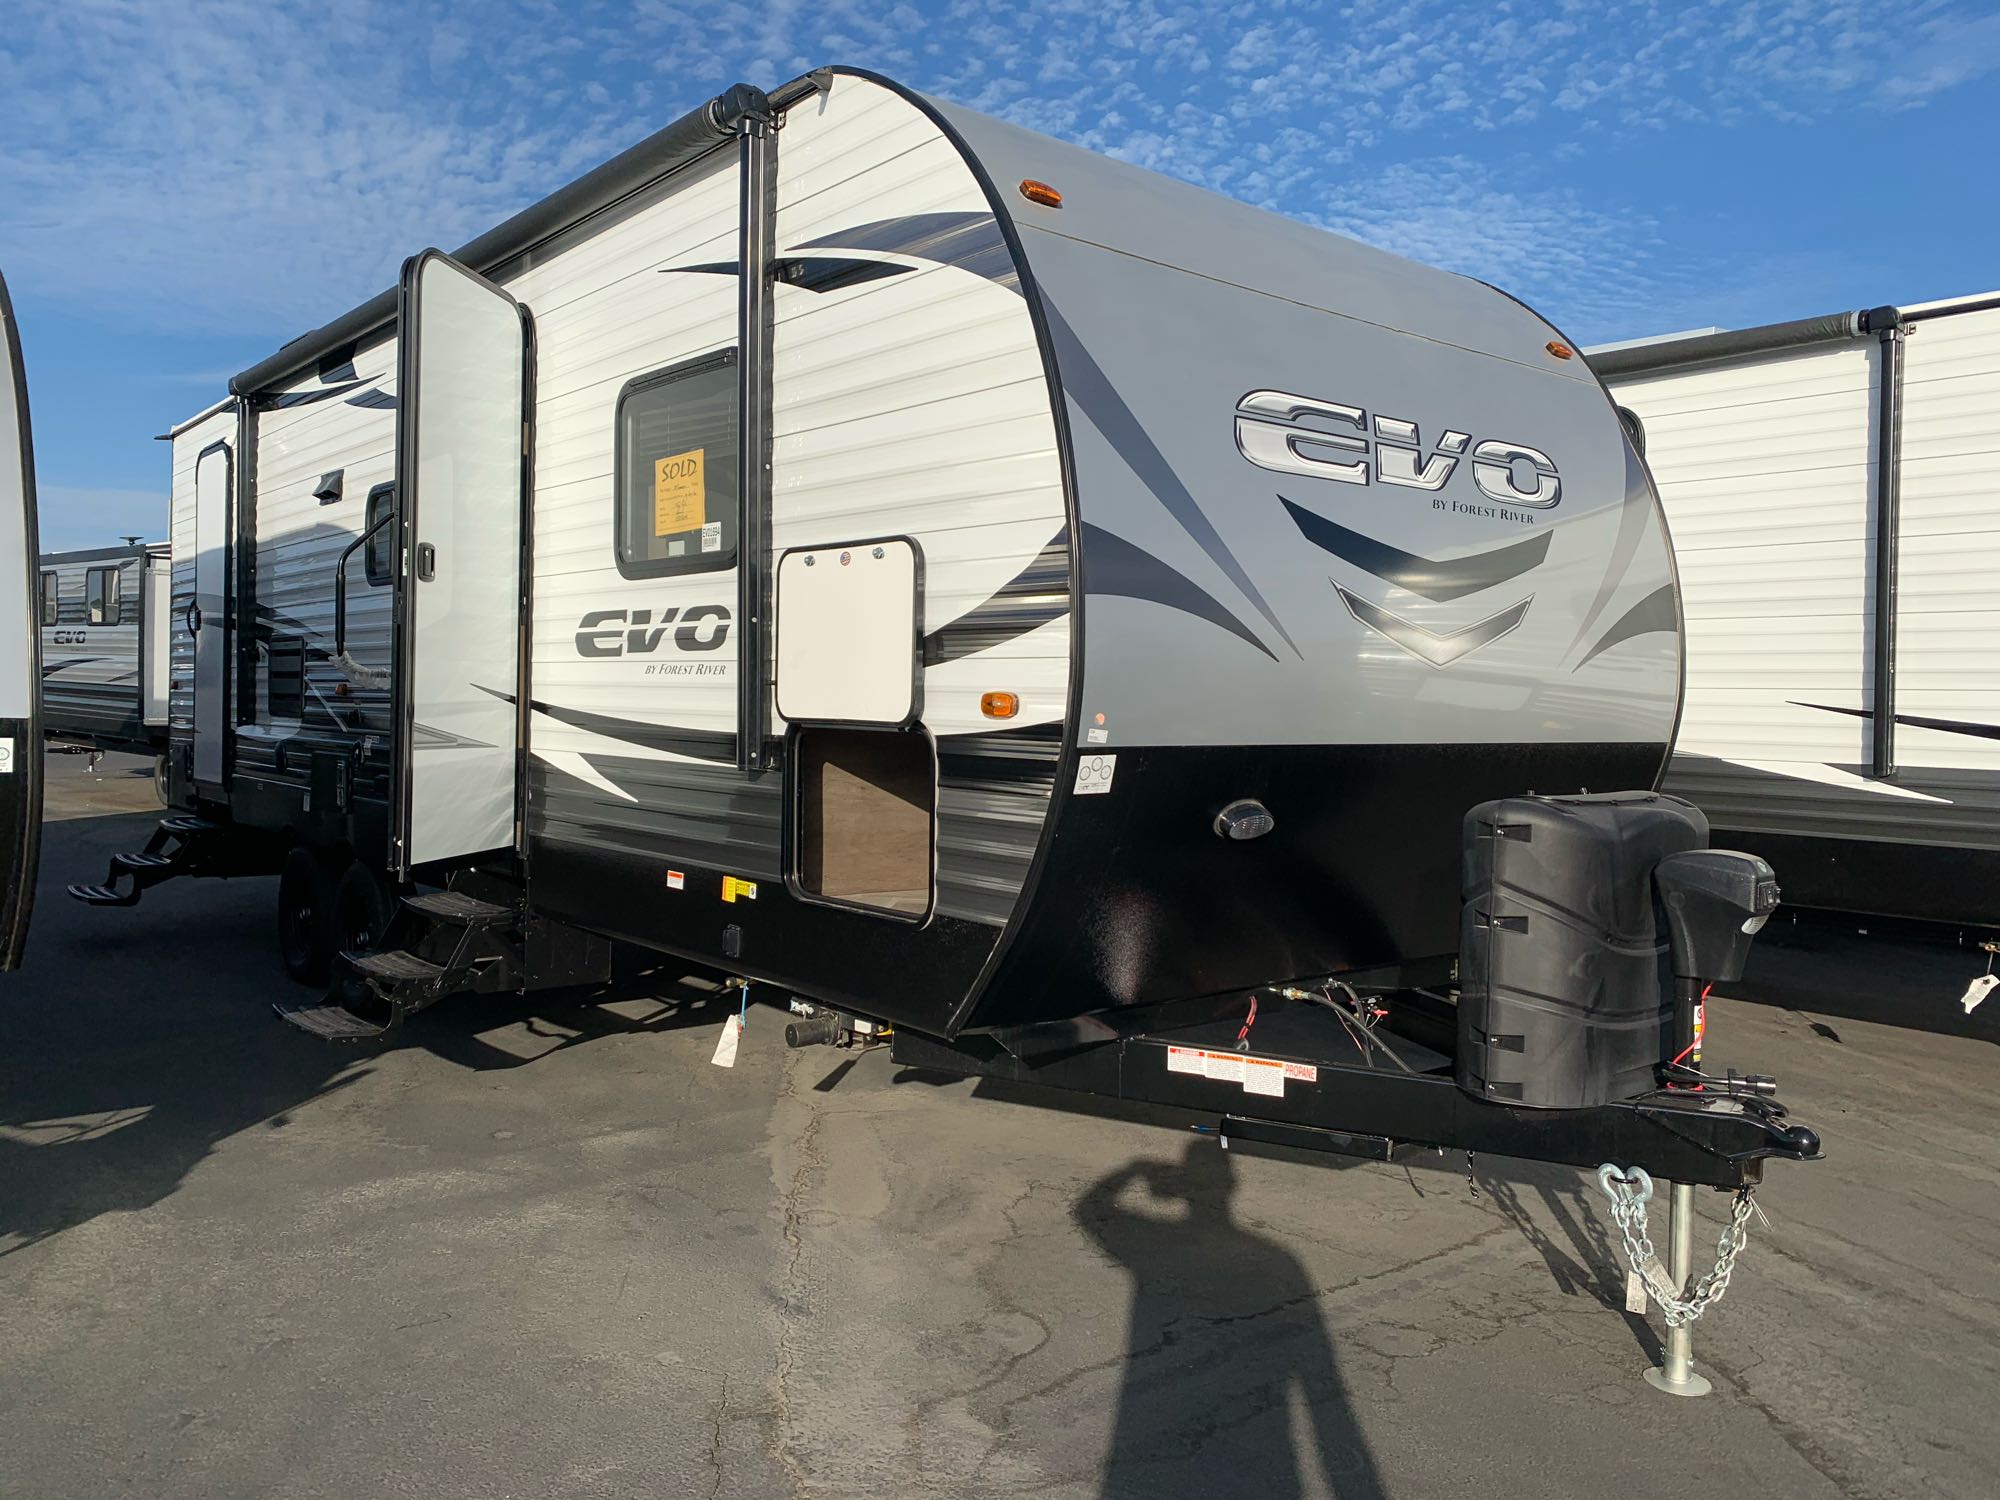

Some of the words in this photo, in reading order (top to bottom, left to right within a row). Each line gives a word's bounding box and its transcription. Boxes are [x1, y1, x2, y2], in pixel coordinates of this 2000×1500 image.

[1234, 389, 1562, 510] EVO
[662, 459, 697, 482] SOLD
[1432, 499, 1447, 510] BY
[1452, 501, 1497, 518] FOREST
[1500, 508, 1534, 525] RIVER
[53, 630, 86, 645] EVO
[575, 604, 732, 658] EVO
[645, 664, 658, 675] BY
[659, 663, 695, 675] FOREST
[696, 663, 727, 675] RIVER
[1285, 1063, 1316, 1080] PROPANE
